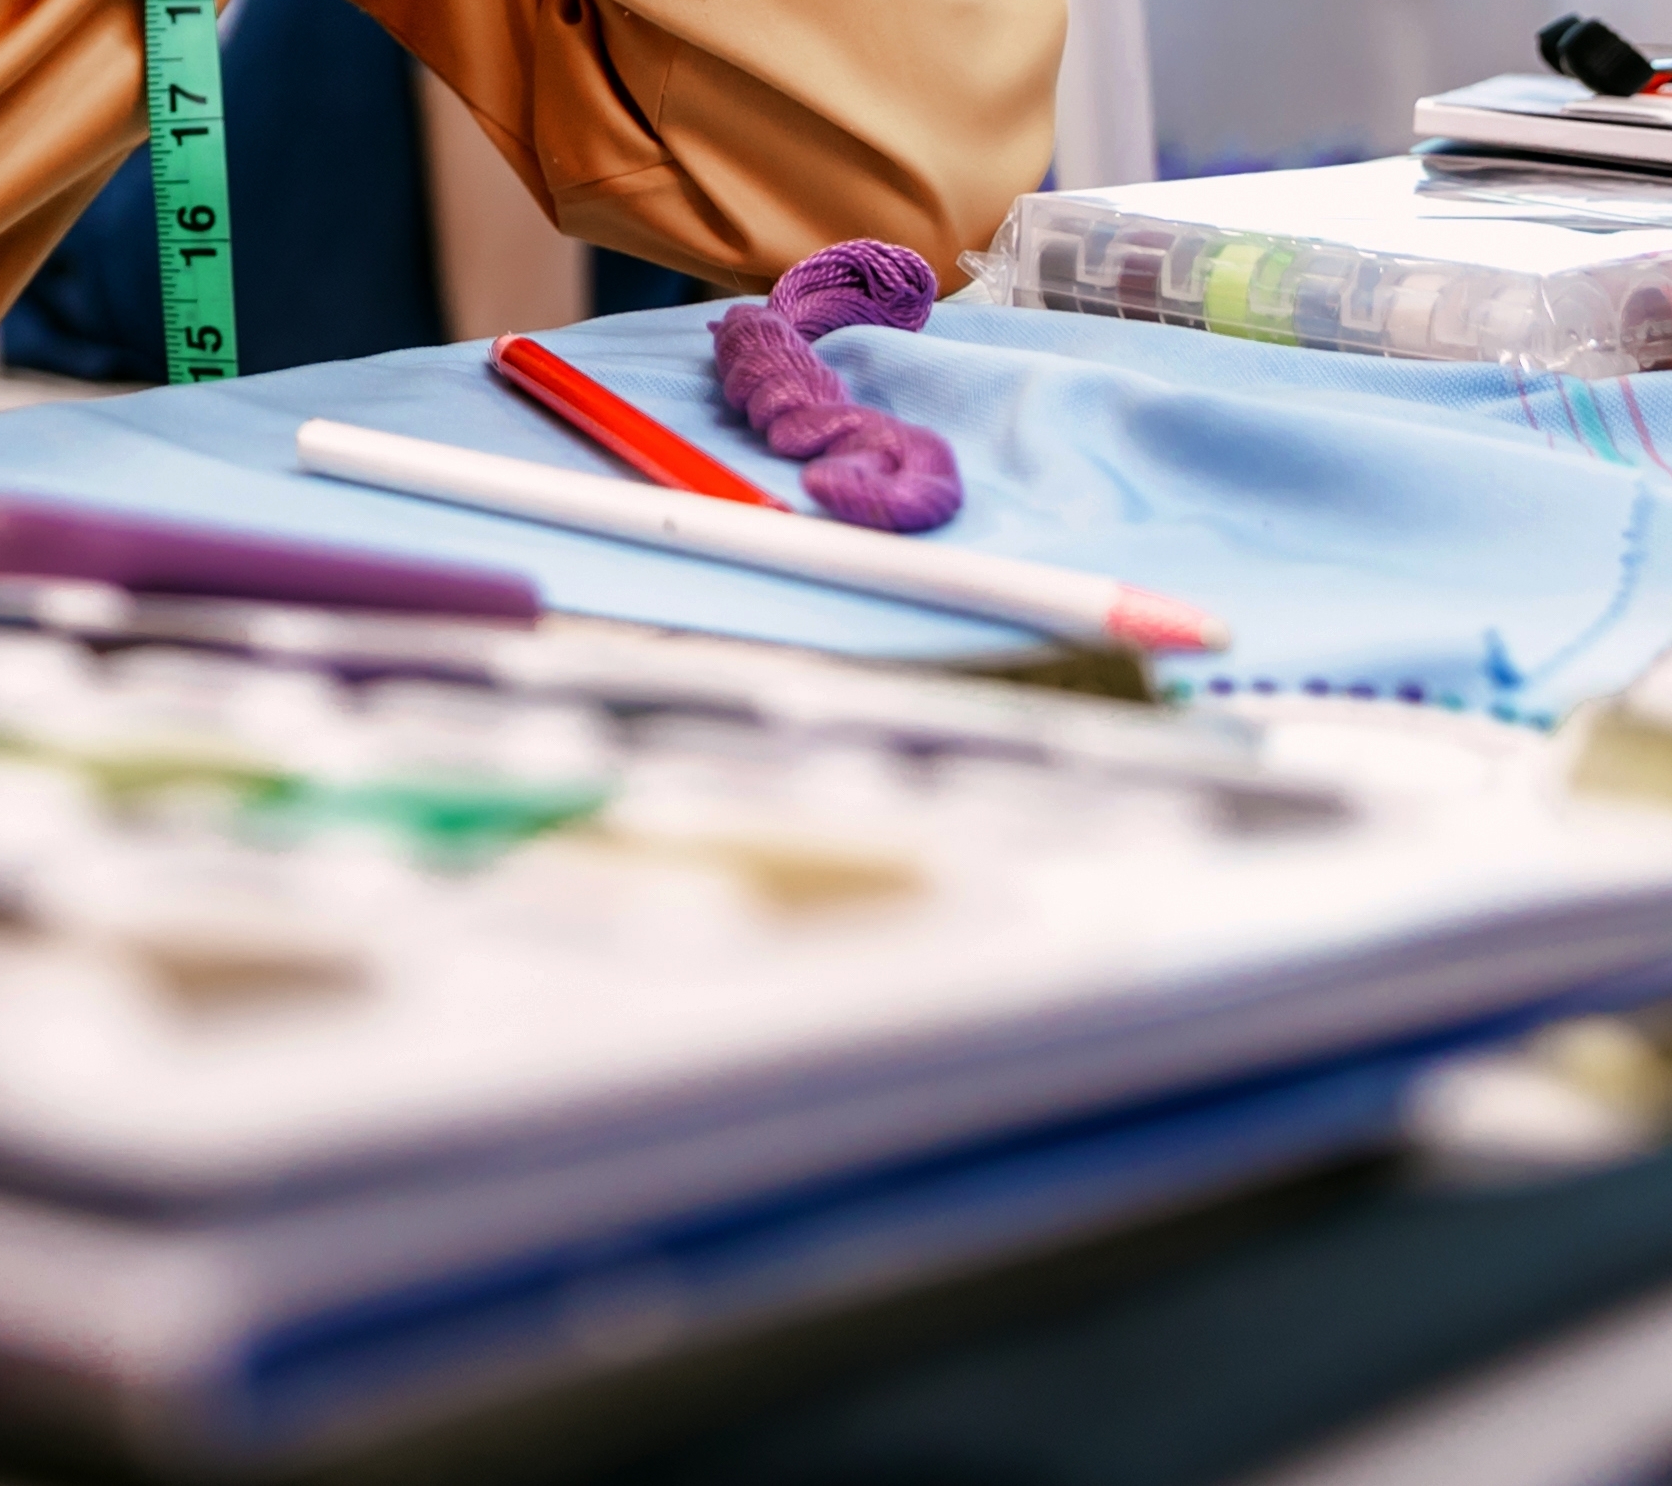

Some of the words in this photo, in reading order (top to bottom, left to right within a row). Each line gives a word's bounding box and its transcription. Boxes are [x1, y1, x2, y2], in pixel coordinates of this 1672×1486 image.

[167, 83, 210, 147] 17
[176, 205, 218, 267] 16
[184, 324, 225, 384] 15
